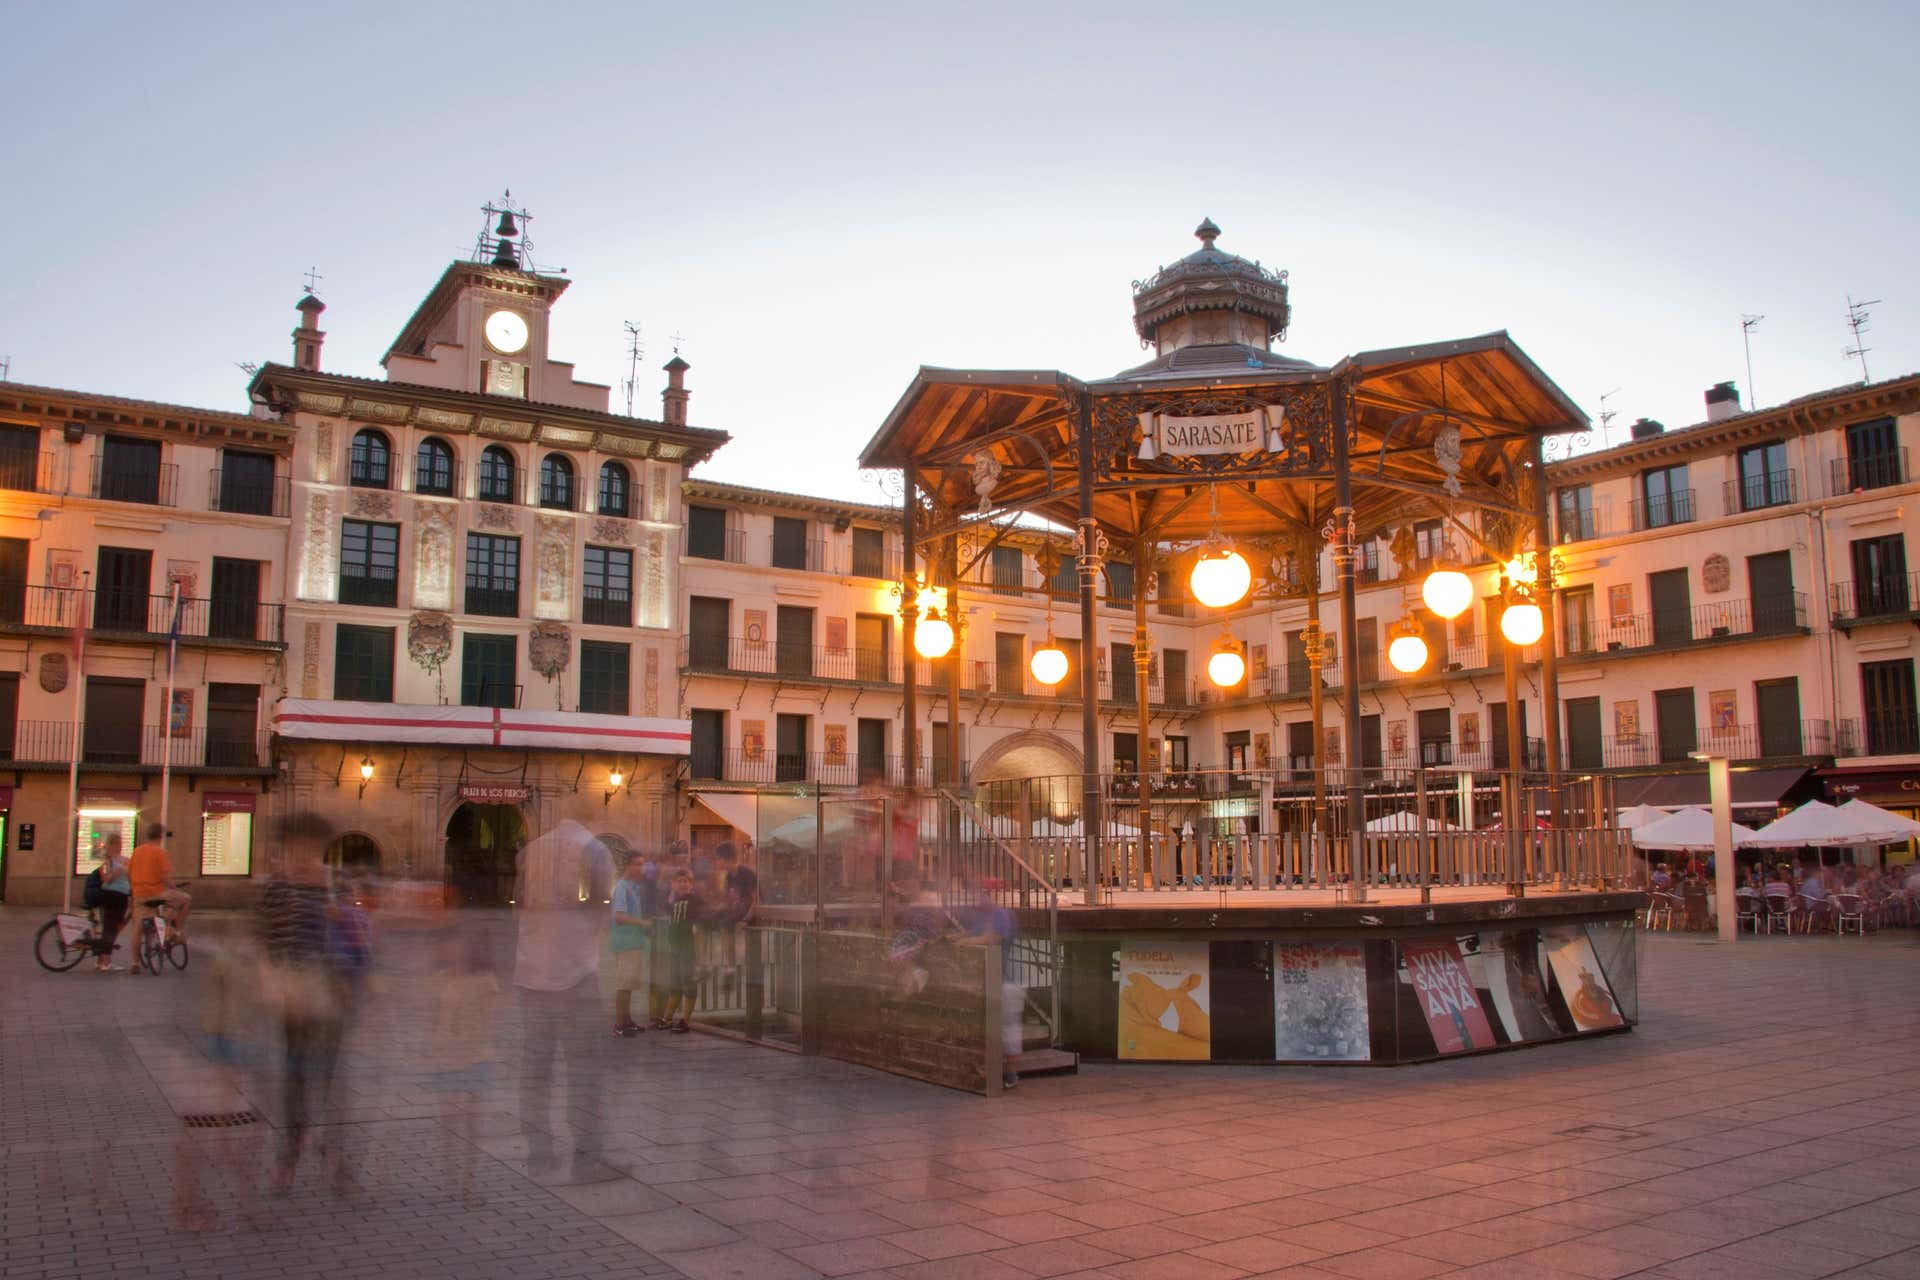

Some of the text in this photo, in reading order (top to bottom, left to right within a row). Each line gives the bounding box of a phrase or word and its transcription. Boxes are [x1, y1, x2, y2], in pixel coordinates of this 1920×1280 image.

[1167, 421, 1257, 447] SARASATE
[463, 787, 479, 797] PLAZA
[489, 788, 503, 798] LOS
[1128, 951, 1175, 961] TUDELA
[1411, 949, 1459, 976] VIVA
[1416, 970, 1470, 991] SANTA
[1427, 985, 1478, 1018] ANA
